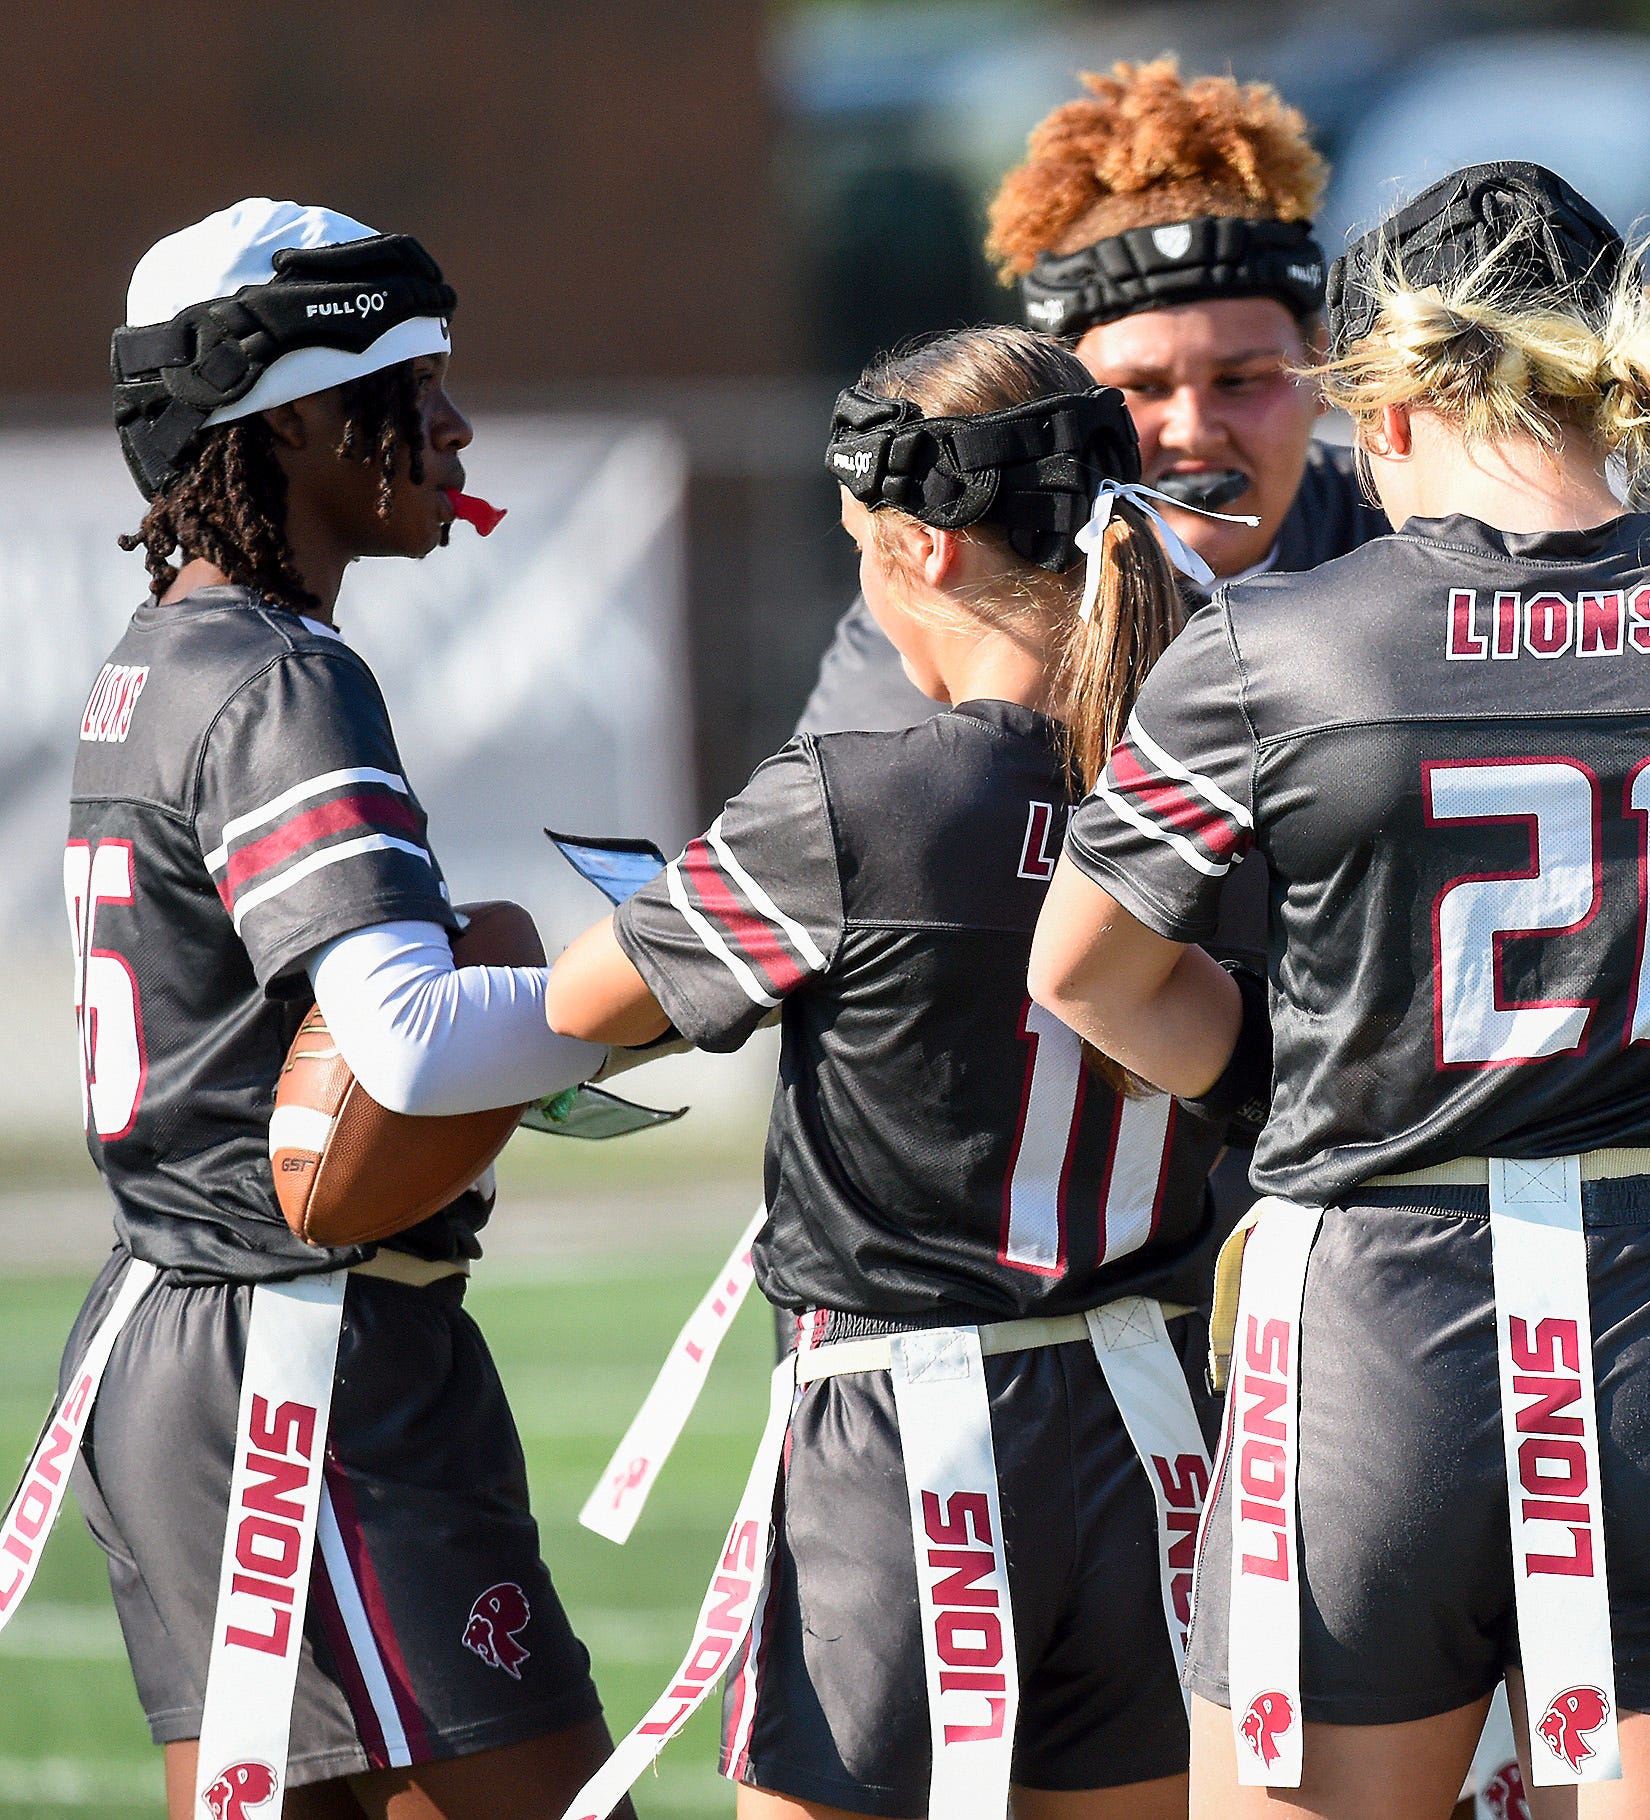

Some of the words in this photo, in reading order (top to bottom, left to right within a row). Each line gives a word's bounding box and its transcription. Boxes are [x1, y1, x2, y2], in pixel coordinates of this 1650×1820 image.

[282, 1158, 315, 1172] GST
[225, 1393, 317, 1659] LIONS
[1239, 1314, 1291, 1581] LIONS
[1509, 1314, 1595, 1579] LIONS
[636, 1519, 760, 1737] LIONS
[920, 1489, 1008, 1746] LIONS
